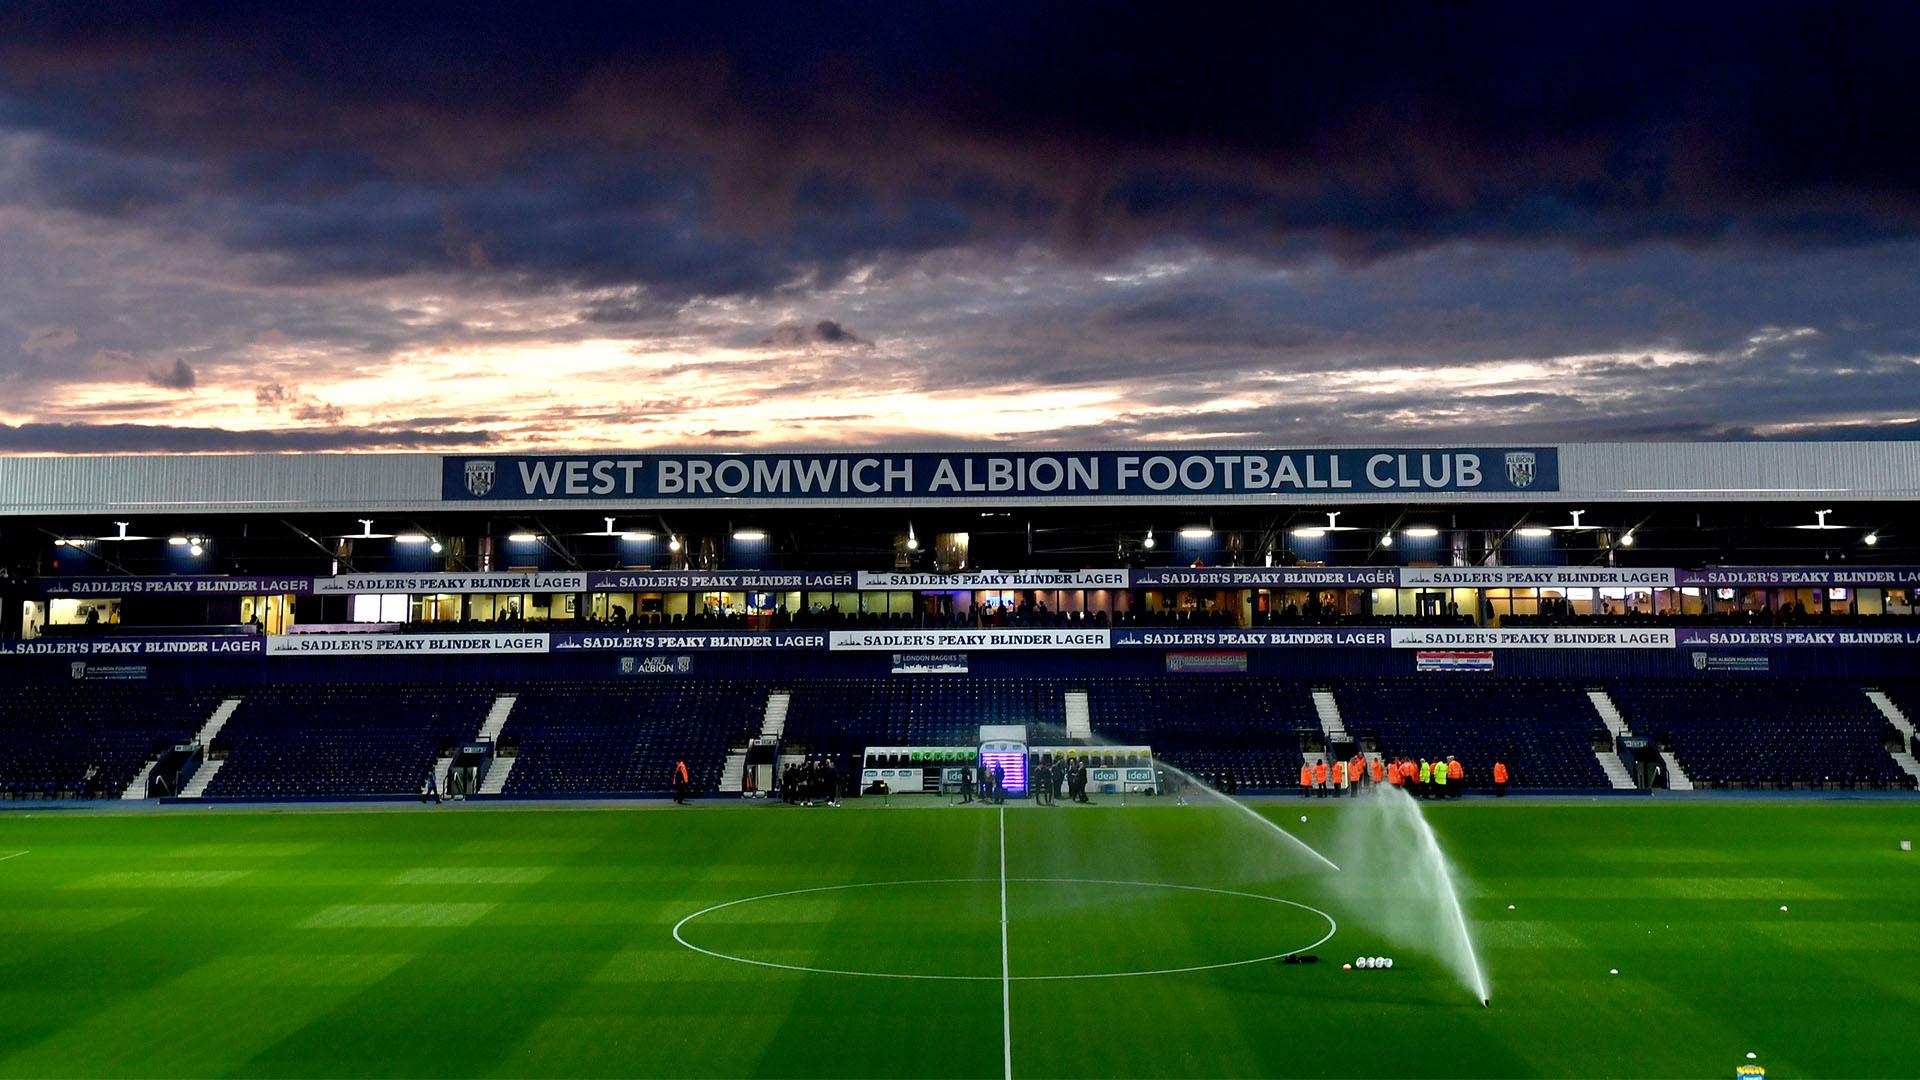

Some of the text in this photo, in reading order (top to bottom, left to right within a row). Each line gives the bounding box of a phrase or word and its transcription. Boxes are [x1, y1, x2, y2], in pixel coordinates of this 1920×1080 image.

[1505, 455, 1535, 463] ALBION
[465, 463, 496, 471] ALBION
[518, 453, 1483, 495] WEST BROMWICH ALBION FOOTBALL CLUB
[619, 576, 851, 587] SADLER'S PEAKY BLINDER LAGER
[890, 574, 1122, 585] SADLER'S PEAKY BLINDER LAGER
[1161, 573, 1394, 584] SADLER'S PEAKY BLINDER LAGER
[1434, 573, 1668, 583] SADLER'S PEAKY BLINDER LAGER
[1708, 572, 1778, 582] SADLER'S
[1782, 572, 1829, 582] PEAKY
[1834, 572, 1895, 581] BLINDER
[72, 581, 307, 592] SADLER'S PEAKY BLINDER LAGER
[347, 578, 581, 590] SADLER'S PEAKY BLINDER LAGER
[582, 637, 823, 648] SADLER'S PEAKY BLINDER LAGER
[863, 635, 1103, 646] SADLER'S PEAKY BLINDER LAGER
[1143, 634, 1385, 644] SADLER'S PEAKY BLINDER LAGER
[1425, 634, 1668, 643] SADLER'S PEAKY BLINDER LAGER
[1711, 633, 1782, 643] SADLER'S
[1786, 633, 1835, 643] PEAKY
[1840, 633, 1903, 643] BLINDER
[16, 641, 260, 653] SADLER'S PEAKY BLINDER LAGER
[301, 639, 542, 650] SADLER'S PEAKY BLINDER LAGER
[638, 664, 674, 672] ALBION
[949, 771, 962, 780] ide
[1094, 770, 1117, 780] ideal
[1128, 769, 1150, 780] ideal
